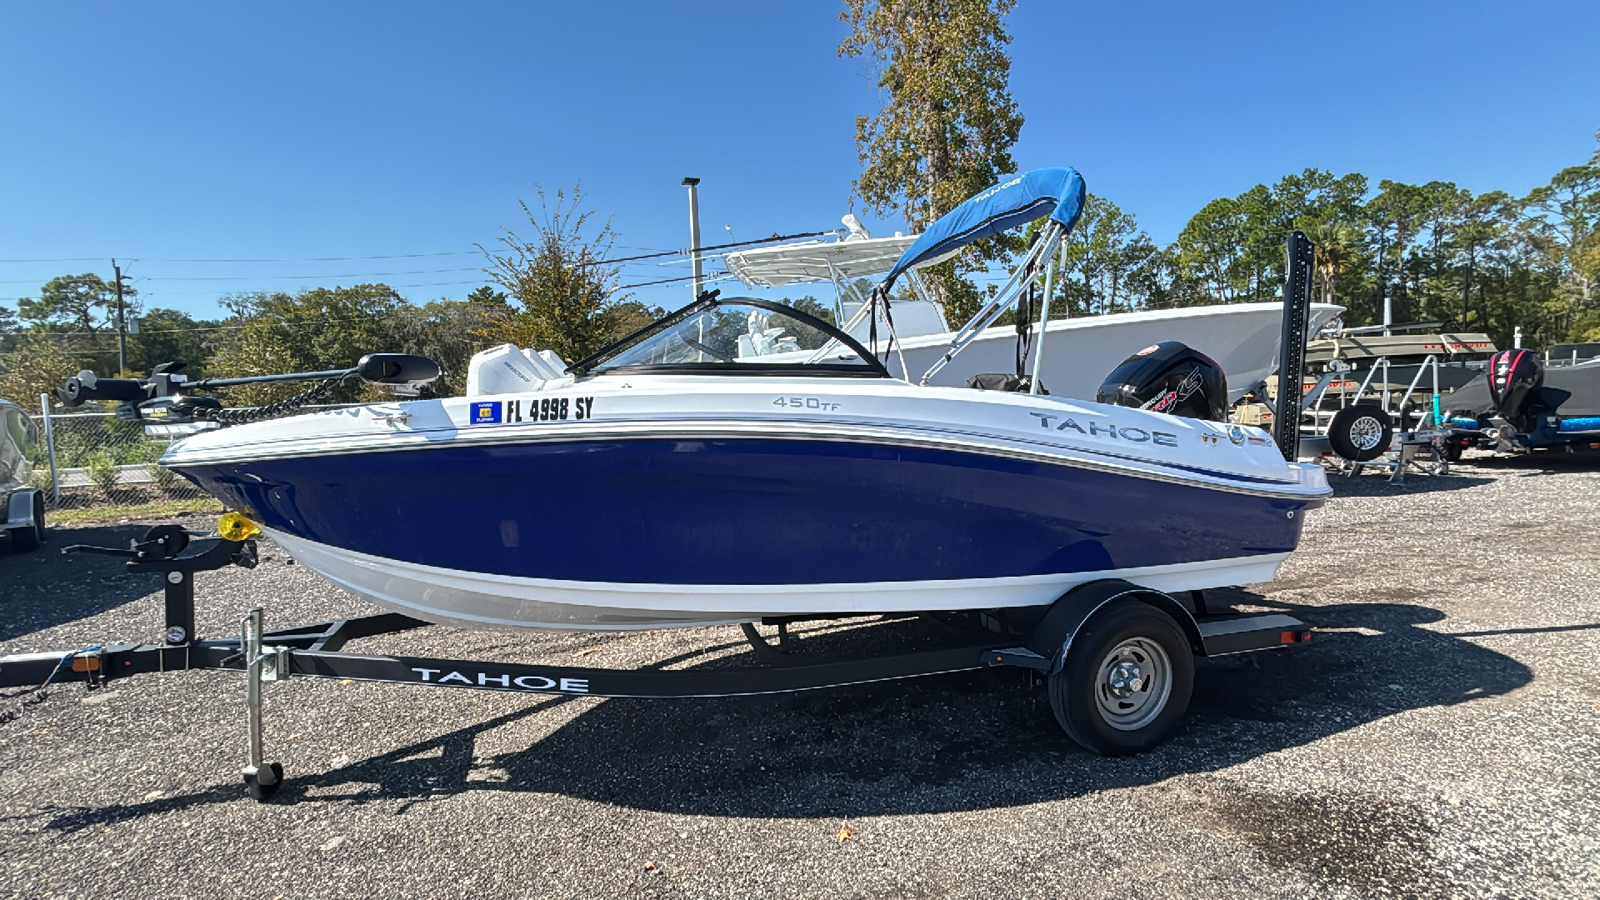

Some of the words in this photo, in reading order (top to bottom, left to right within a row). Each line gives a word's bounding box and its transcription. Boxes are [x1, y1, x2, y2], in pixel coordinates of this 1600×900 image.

[974, 177, 1021, 203] TAHOE
[506, 400, 522, 423] FL
[529, 398, 569, 422] 4998
[575, 396, 594, 420] SY
[1029, 411, 1178, 447] TAHOE
[411, 667, 589, 693] TAHOE
